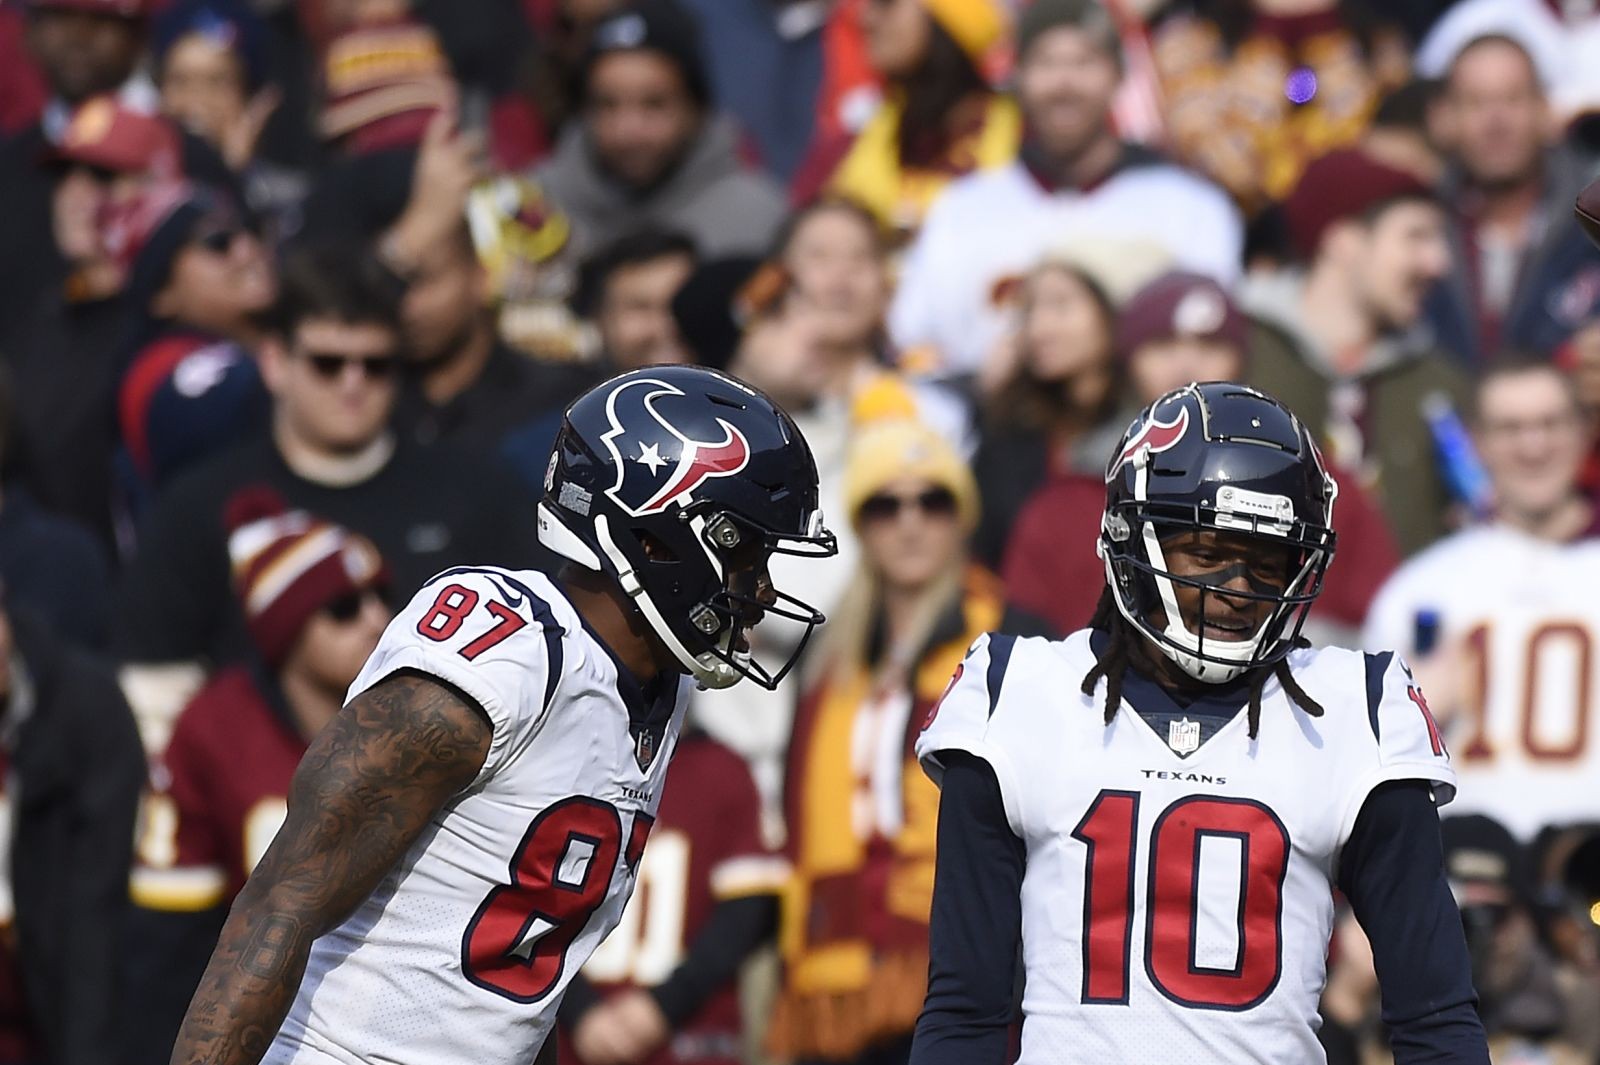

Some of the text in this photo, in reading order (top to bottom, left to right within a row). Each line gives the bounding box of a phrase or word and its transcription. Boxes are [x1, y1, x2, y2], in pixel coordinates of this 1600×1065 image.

[1240, 500, 1273, 511] TEXANS
[416, 583, 528, 662] 87
[1140, 769, 1227, 785] TEXANS
[621, 786, 653, 803] TEXANS
[1070, 788, 1292, 1013] 10
